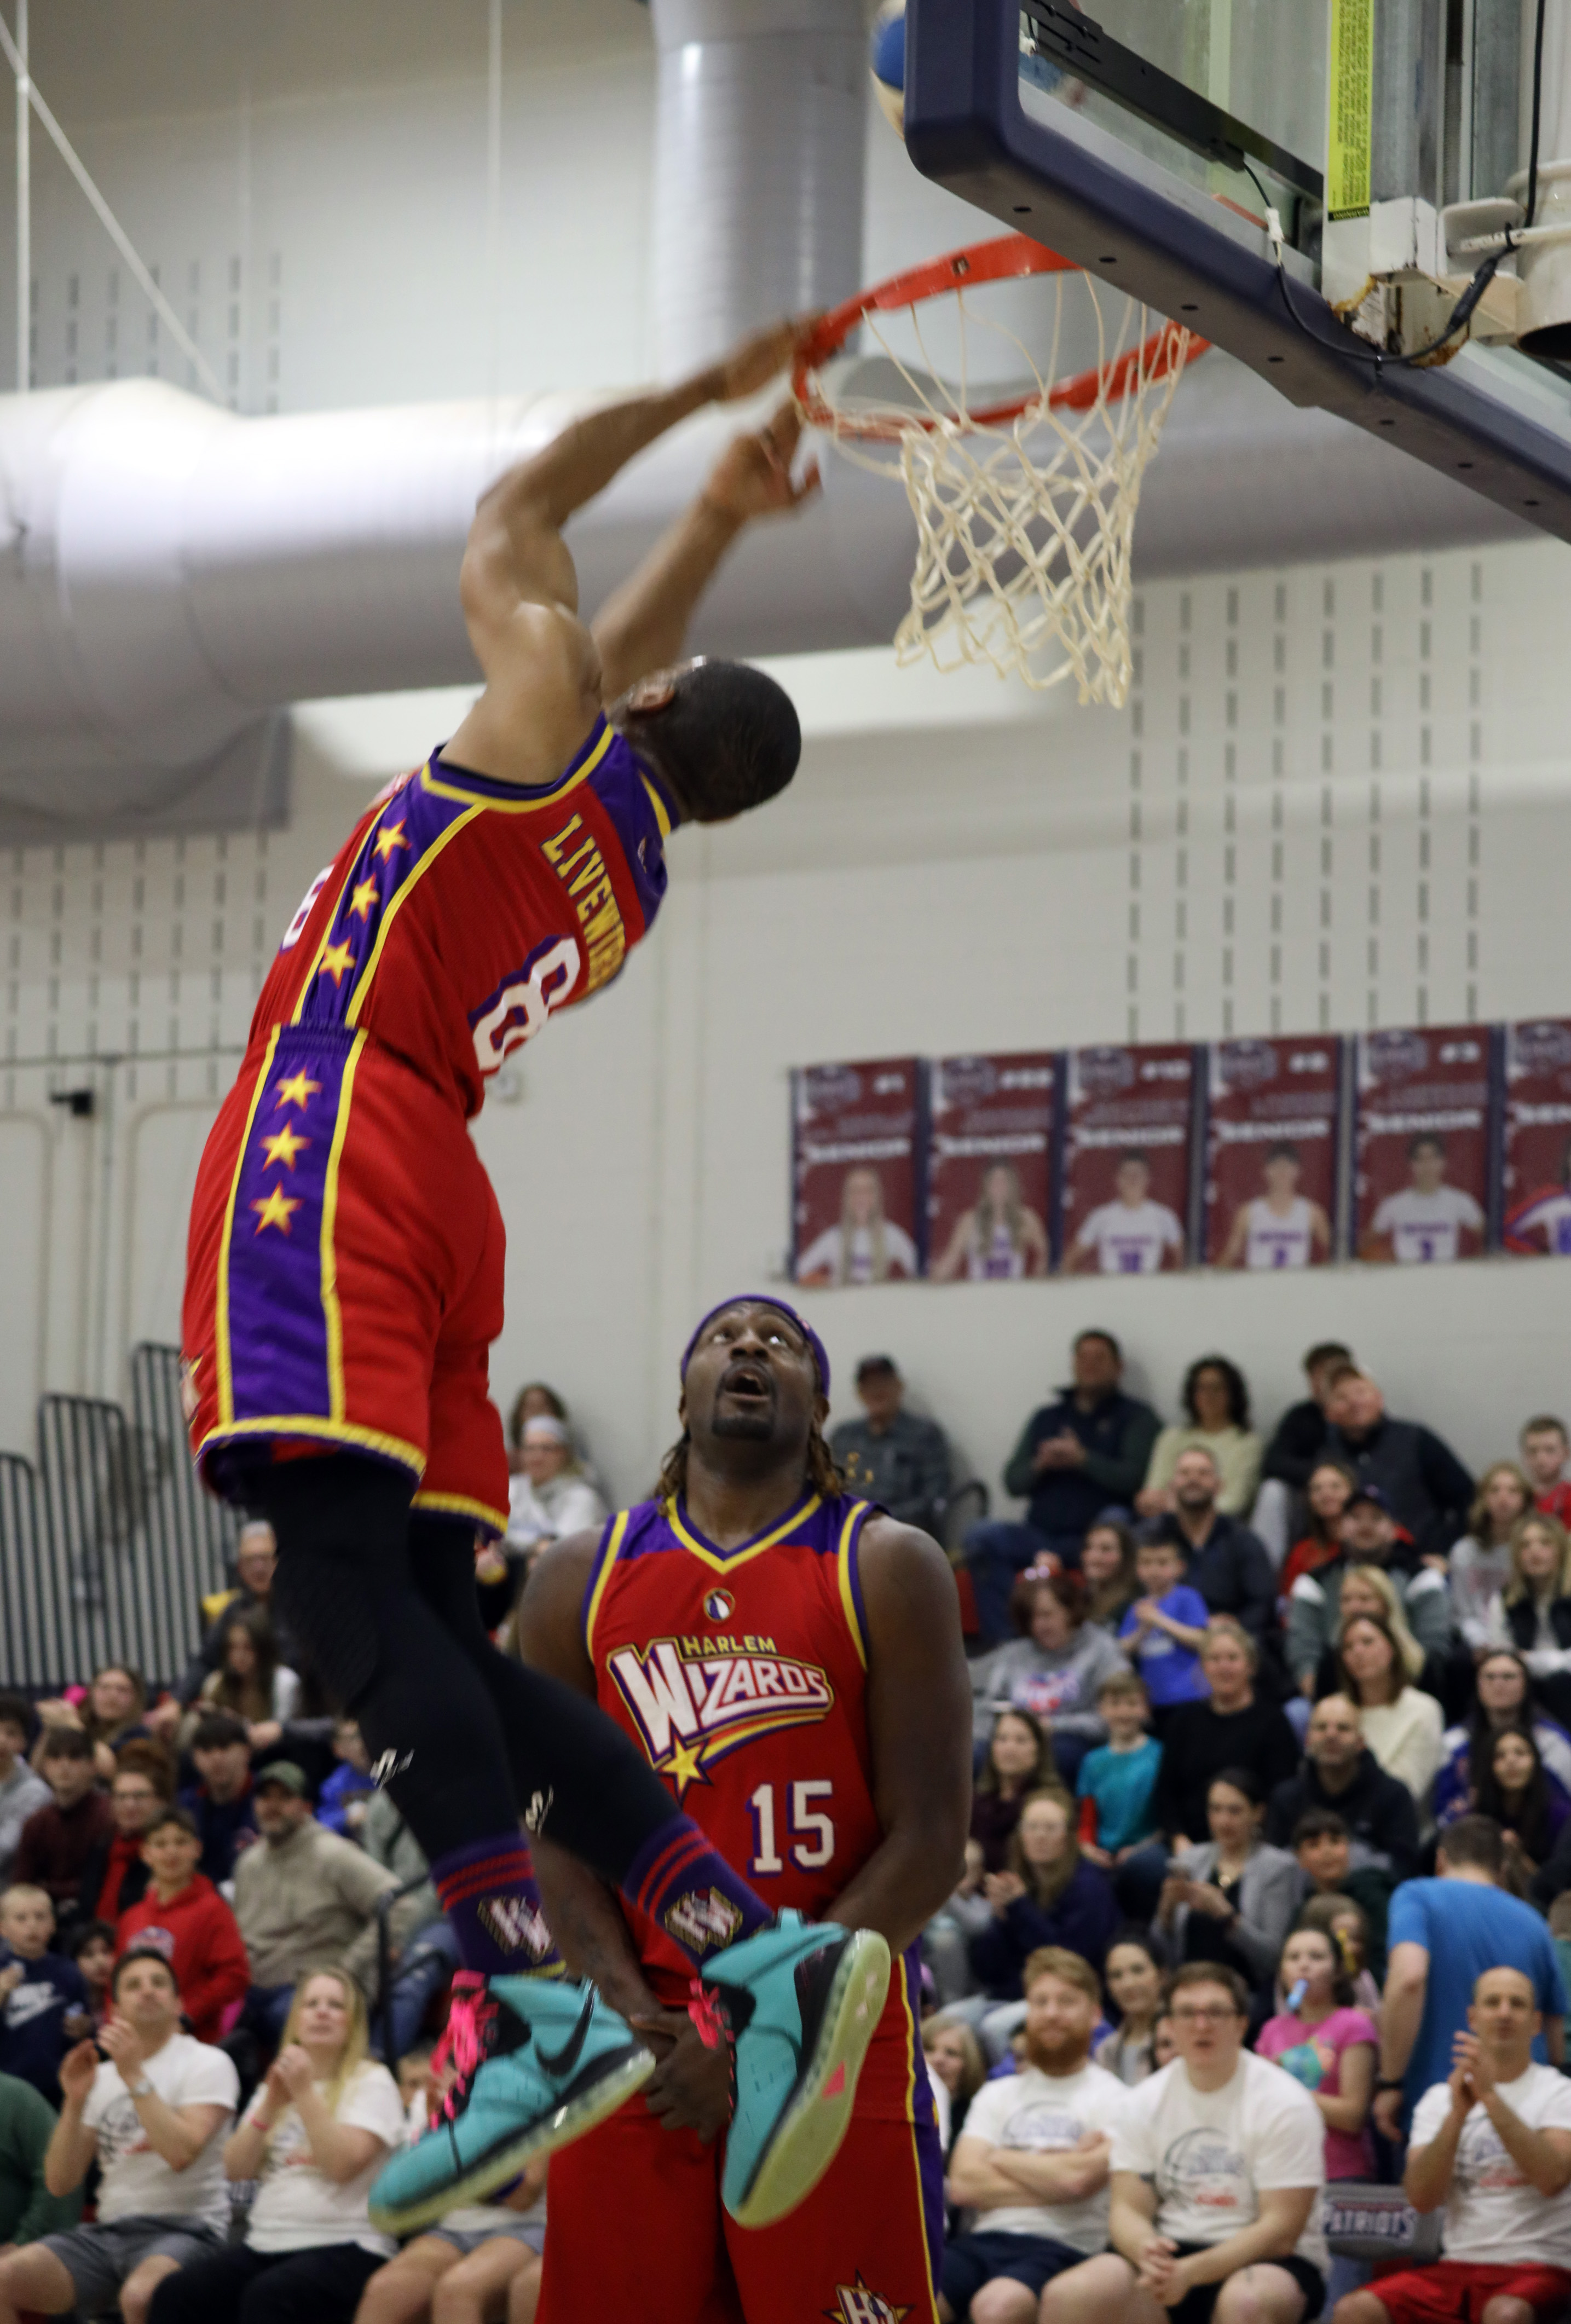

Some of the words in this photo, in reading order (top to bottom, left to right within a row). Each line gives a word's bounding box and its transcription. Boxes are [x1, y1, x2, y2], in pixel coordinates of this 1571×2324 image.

[470, 935, 580, 1071] 8
[684, 1635, 777, 1656] HARLEM
[609, 1641, 831, 1758] WIZARDS
[750, 1780, 835, 1876] 15
